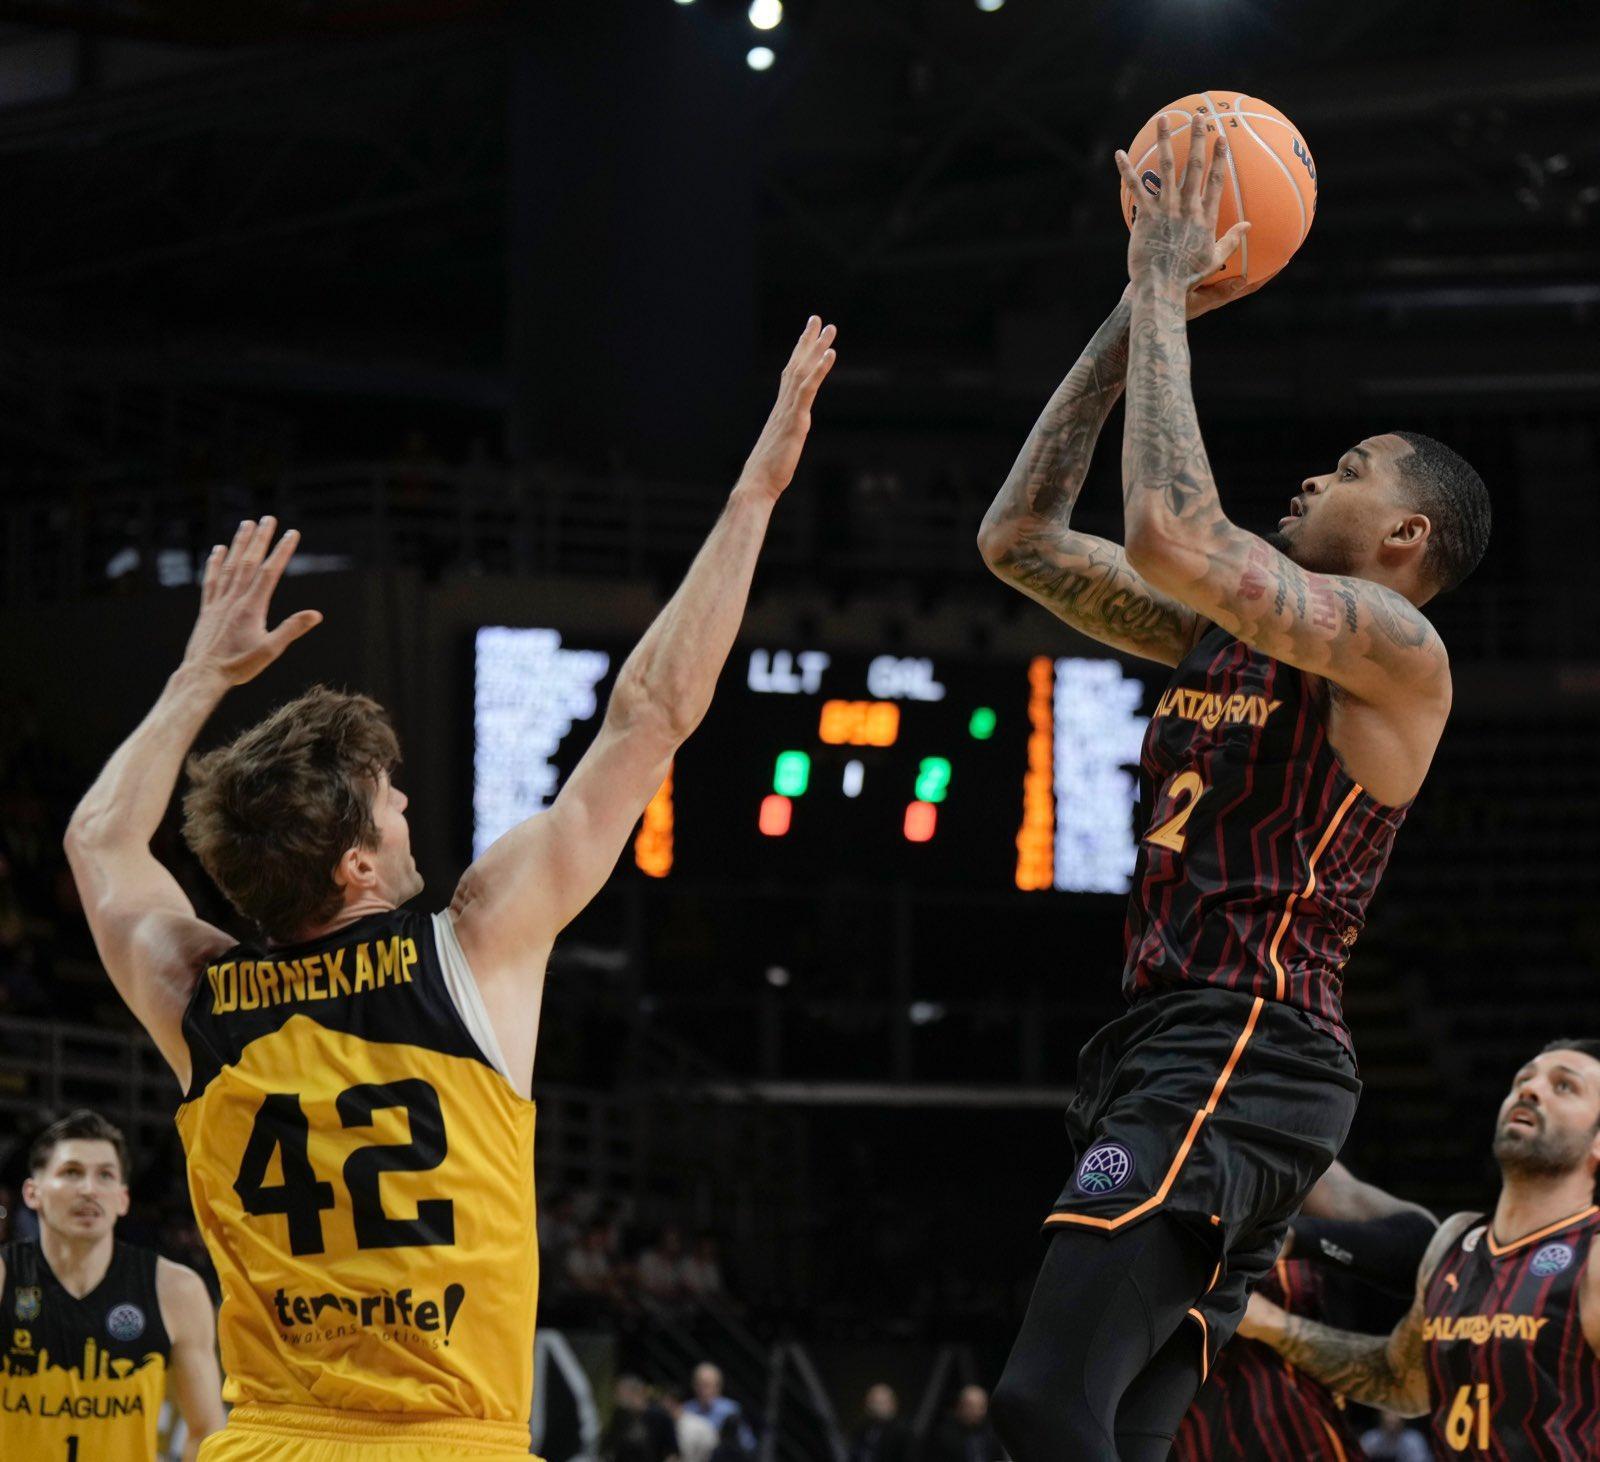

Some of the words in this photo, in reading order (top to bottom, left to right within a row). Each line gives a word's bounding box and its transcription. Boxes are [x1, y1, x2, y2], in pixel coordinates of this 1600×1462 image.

[748, 650, 831, 694] LLT
[233, 1078, 455, 1256] 42
[2, 1387, 32, 1415] LA
[39, 1394, 145, 1419] LAGUNA
[1445, 1383, 1491, 1451] 61
